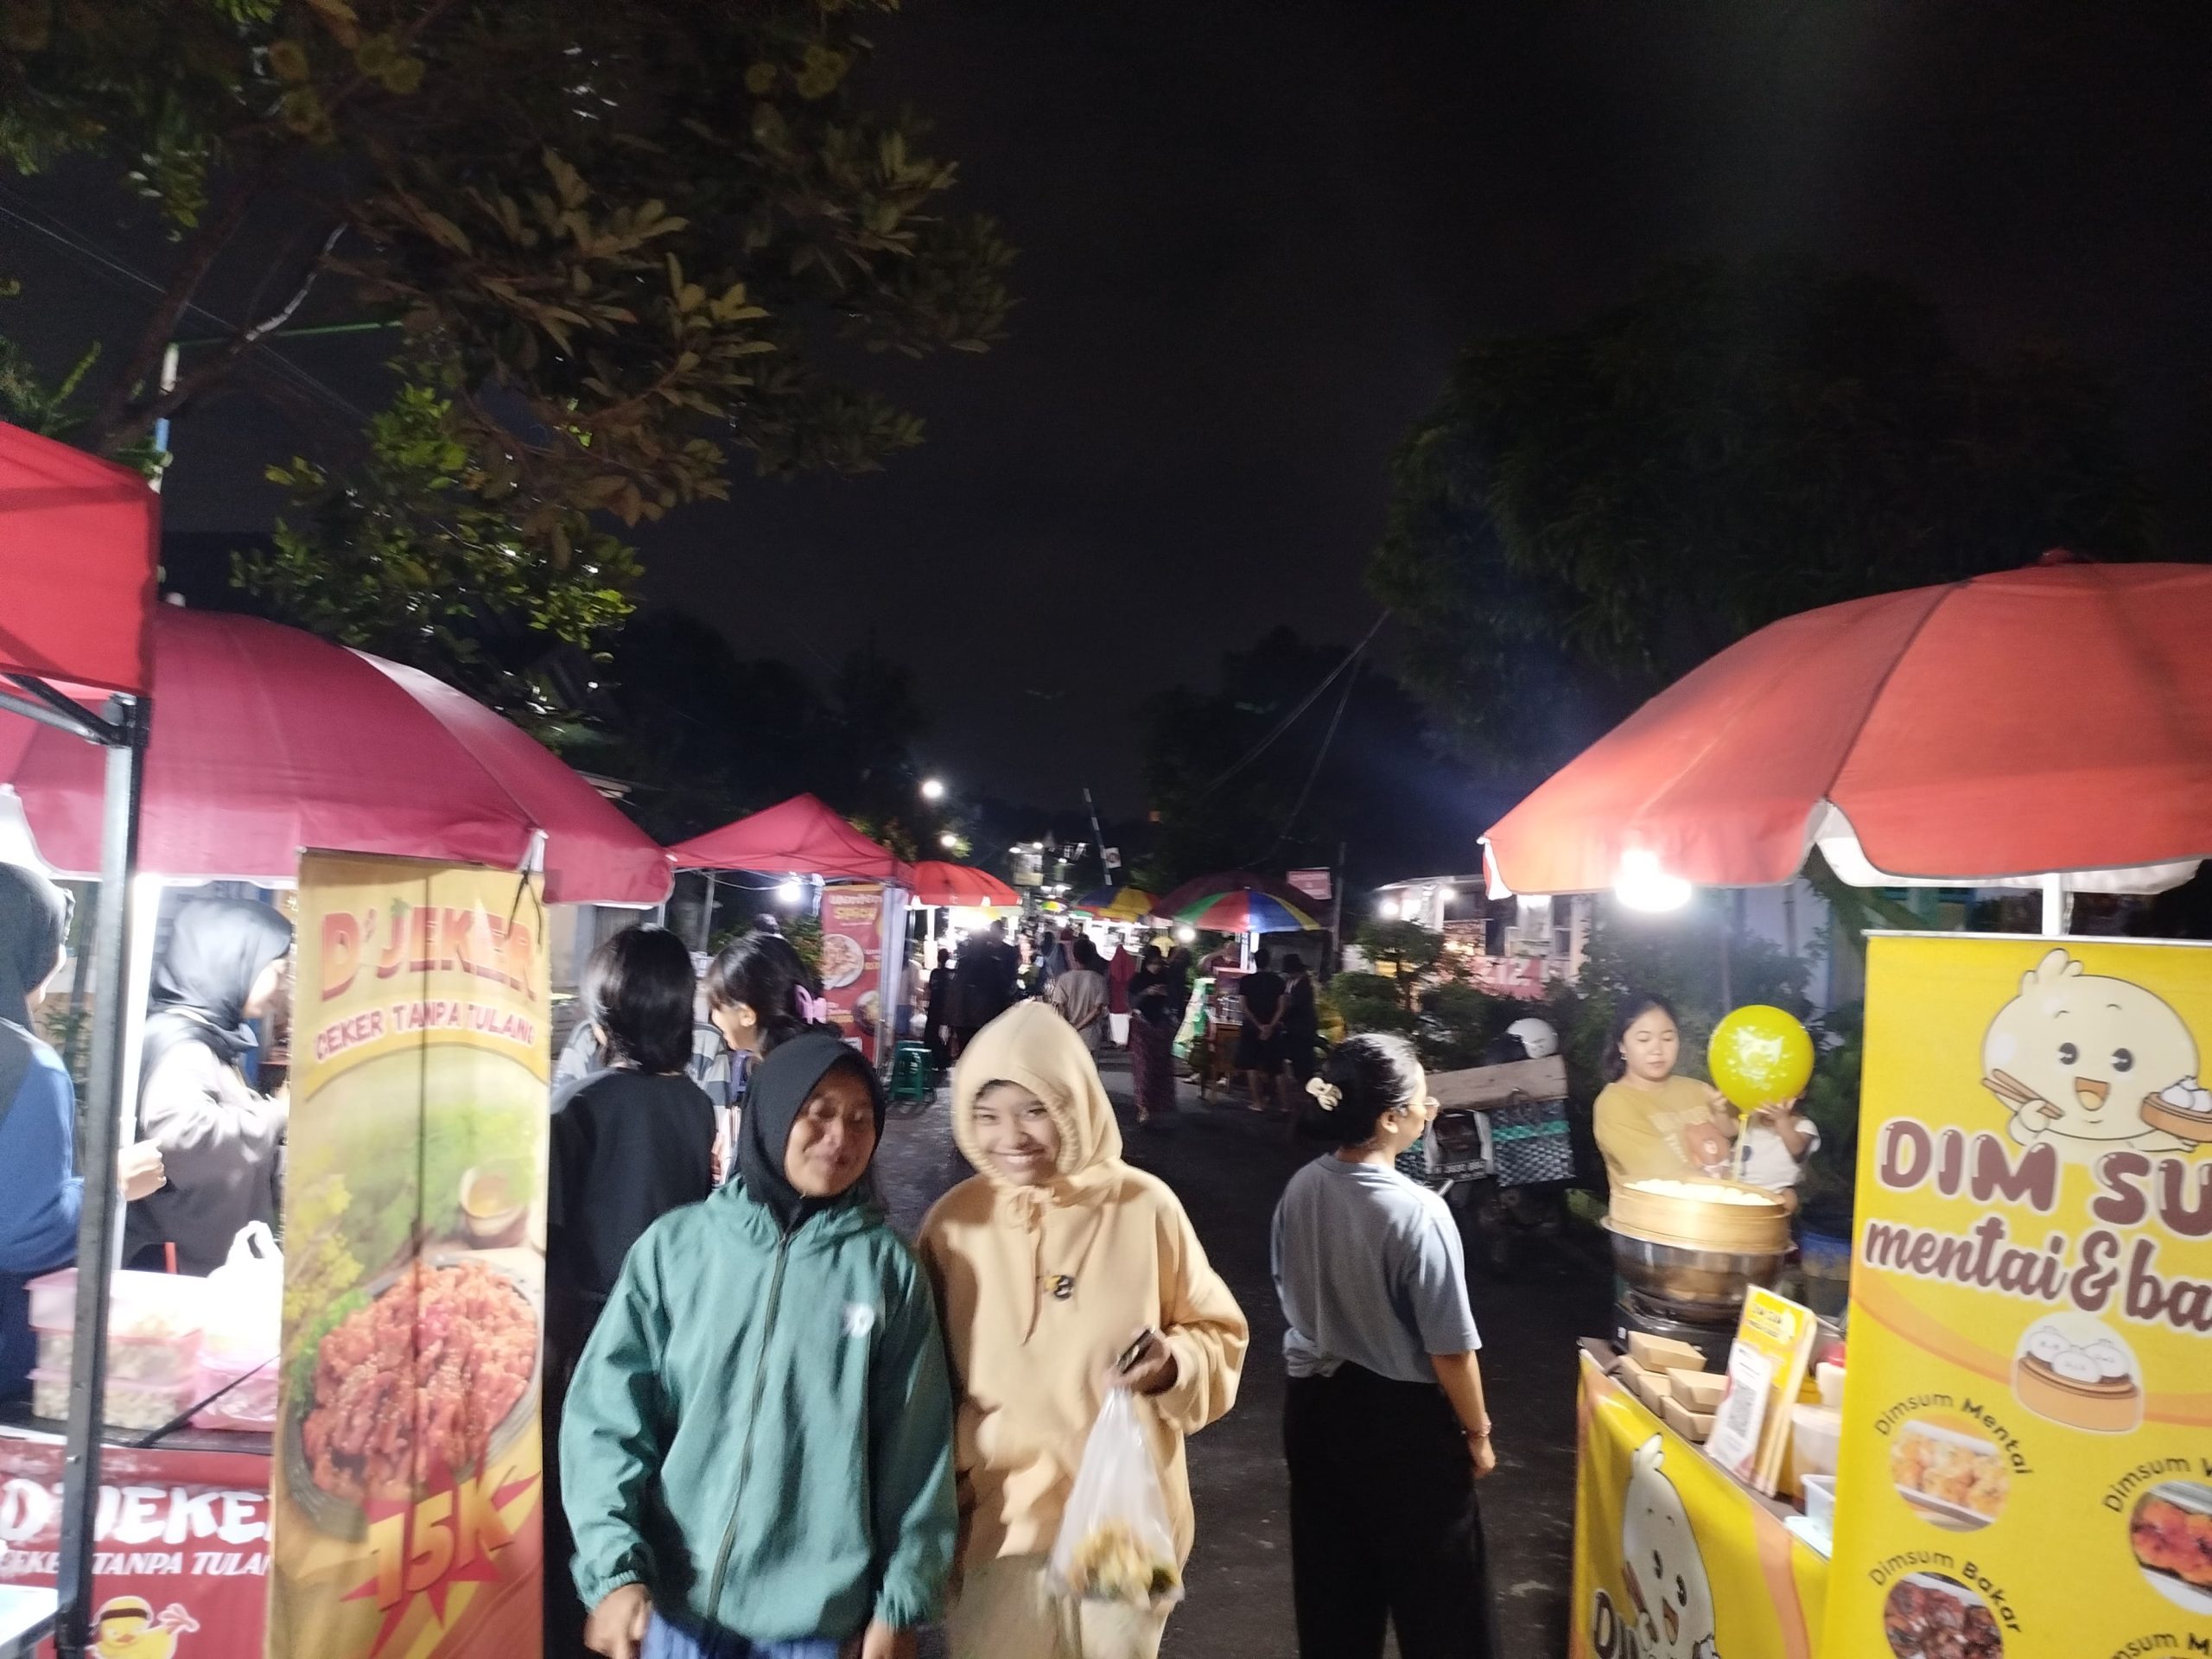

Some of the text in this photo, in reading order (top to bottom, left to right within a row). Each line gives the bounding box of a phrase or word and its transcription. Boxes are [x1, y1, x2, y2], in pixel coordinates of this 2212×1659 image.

[321, 905, 537, 1002] D'JEKER
[315, 1001, 536, 1061] CEKER TANPA TULANG
[1880, 1120, 2056, 1211] DIM
[1873, 1394, 1955, 1435] Dimsum
[2101, 1457, 2191, 1513] Dimsum
[92, 1553, 183, 1576] TANPA
[369, 1462, 518, 1612] 15K
[1868, 1552, 2021, 1633] Dimsum Bakar
